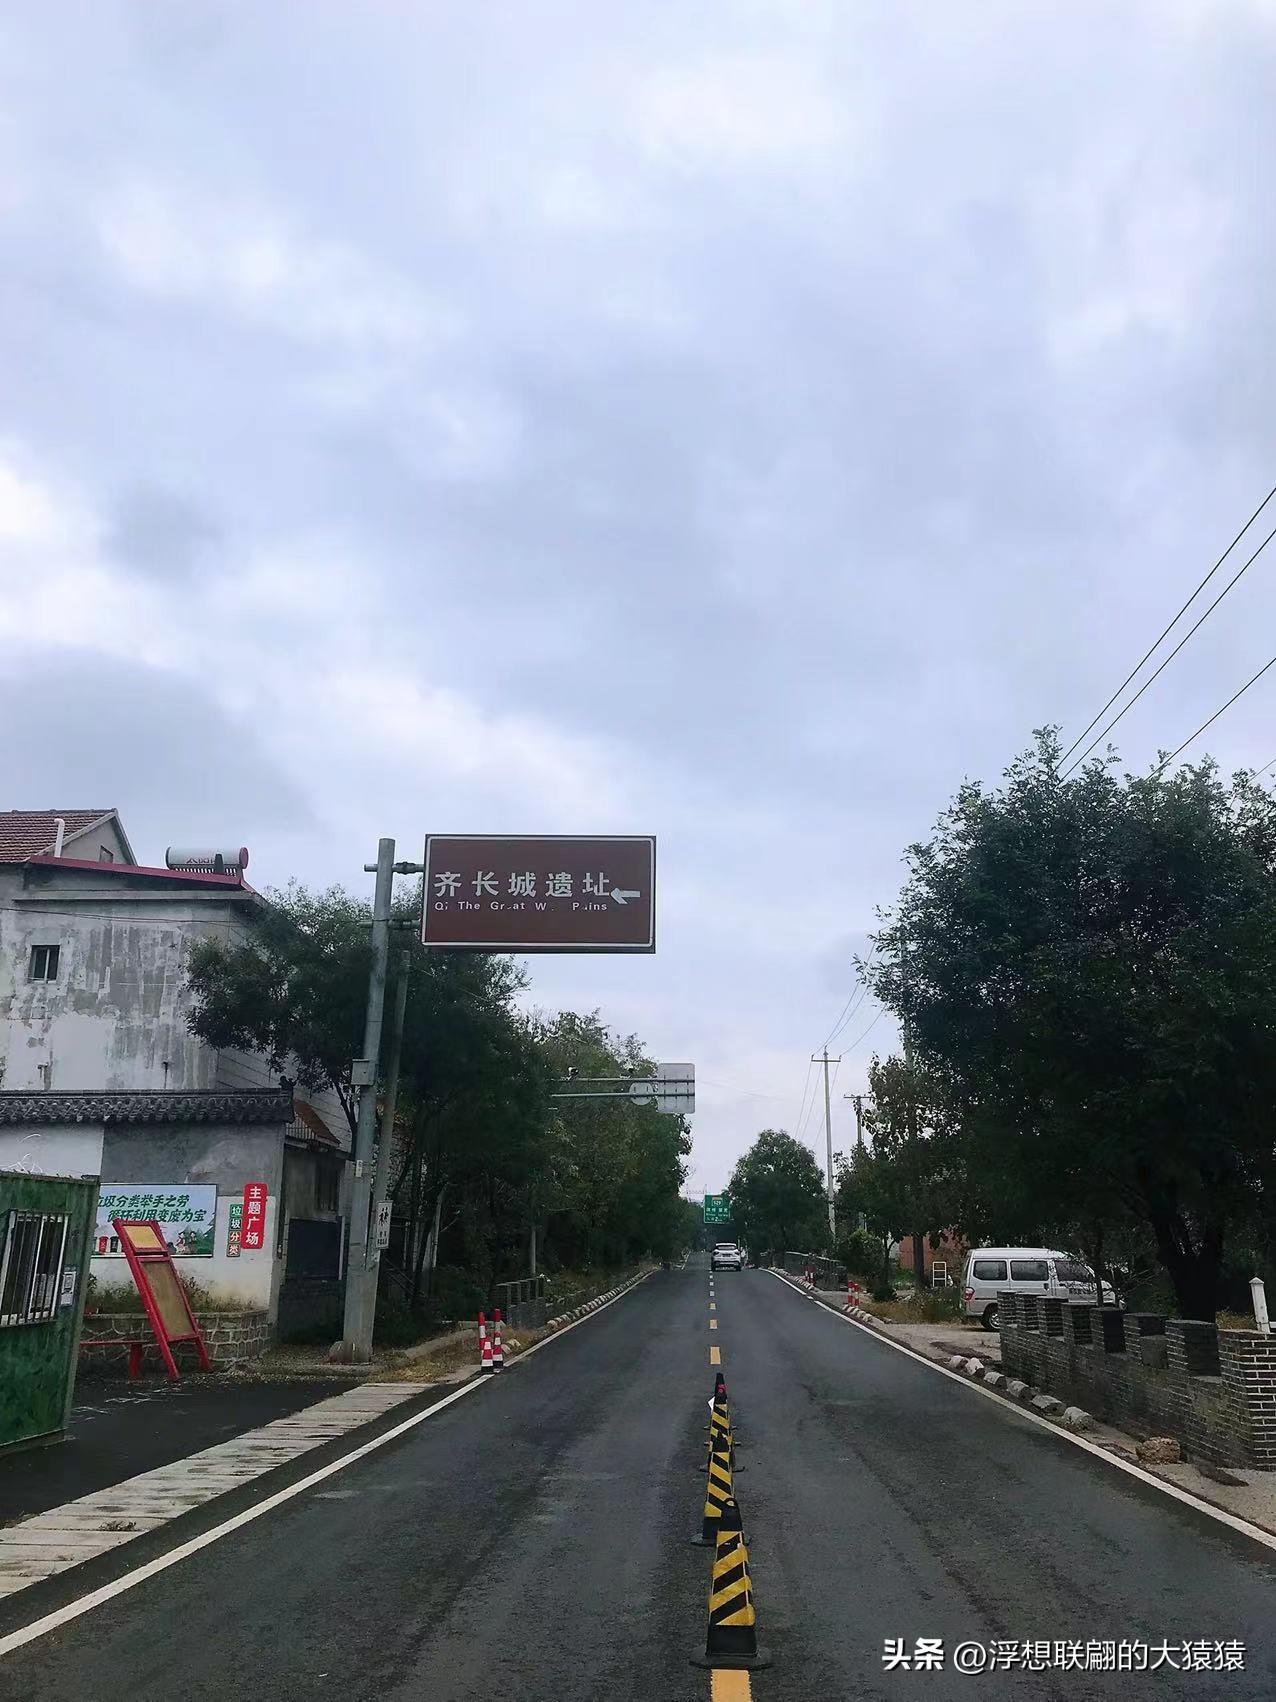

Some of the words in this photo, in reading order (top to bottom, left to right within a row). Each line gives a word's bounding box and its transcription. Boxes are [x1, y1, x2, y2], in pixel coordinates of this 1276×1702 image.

[434, 871, 610, 898] 齐长城遗址
[458, 901, 481, 911] The
[490, 901, 526, 911] Grat
[229, 1206, 242, 1255] 垃圾分类
[246, 1186, 261, 1246] 主题广场
